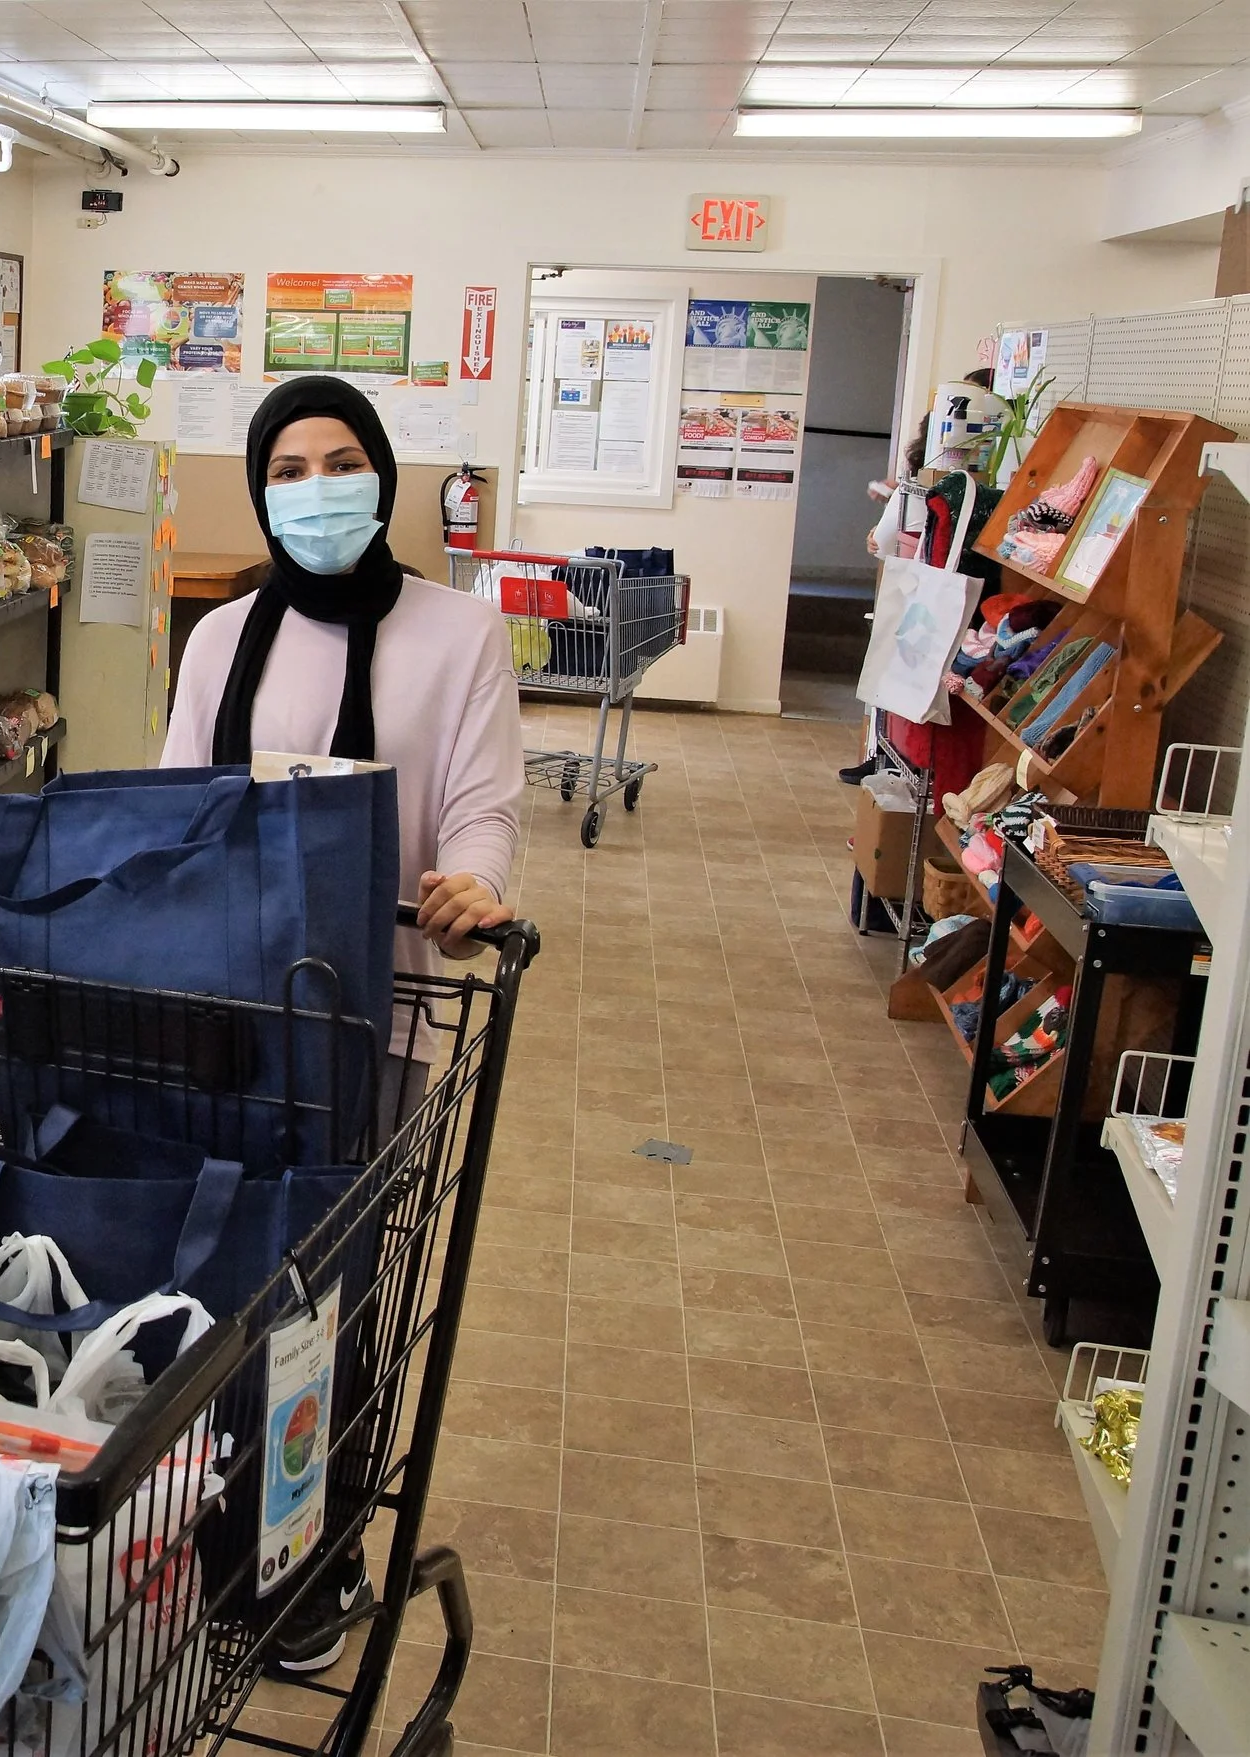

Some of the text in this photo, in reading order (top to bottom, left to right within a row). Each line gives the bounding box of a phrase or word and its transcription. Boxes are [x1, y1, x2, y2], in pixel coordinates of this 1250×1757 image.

[702, 200, 759, 241] EXIT
[276, 278, 320, 287] Welcome!
[467, 293, 493, 306] FIRE
[473, 306, 482, 373] EXTINGUISHER
[274, 1346, 299, 1368] Family
